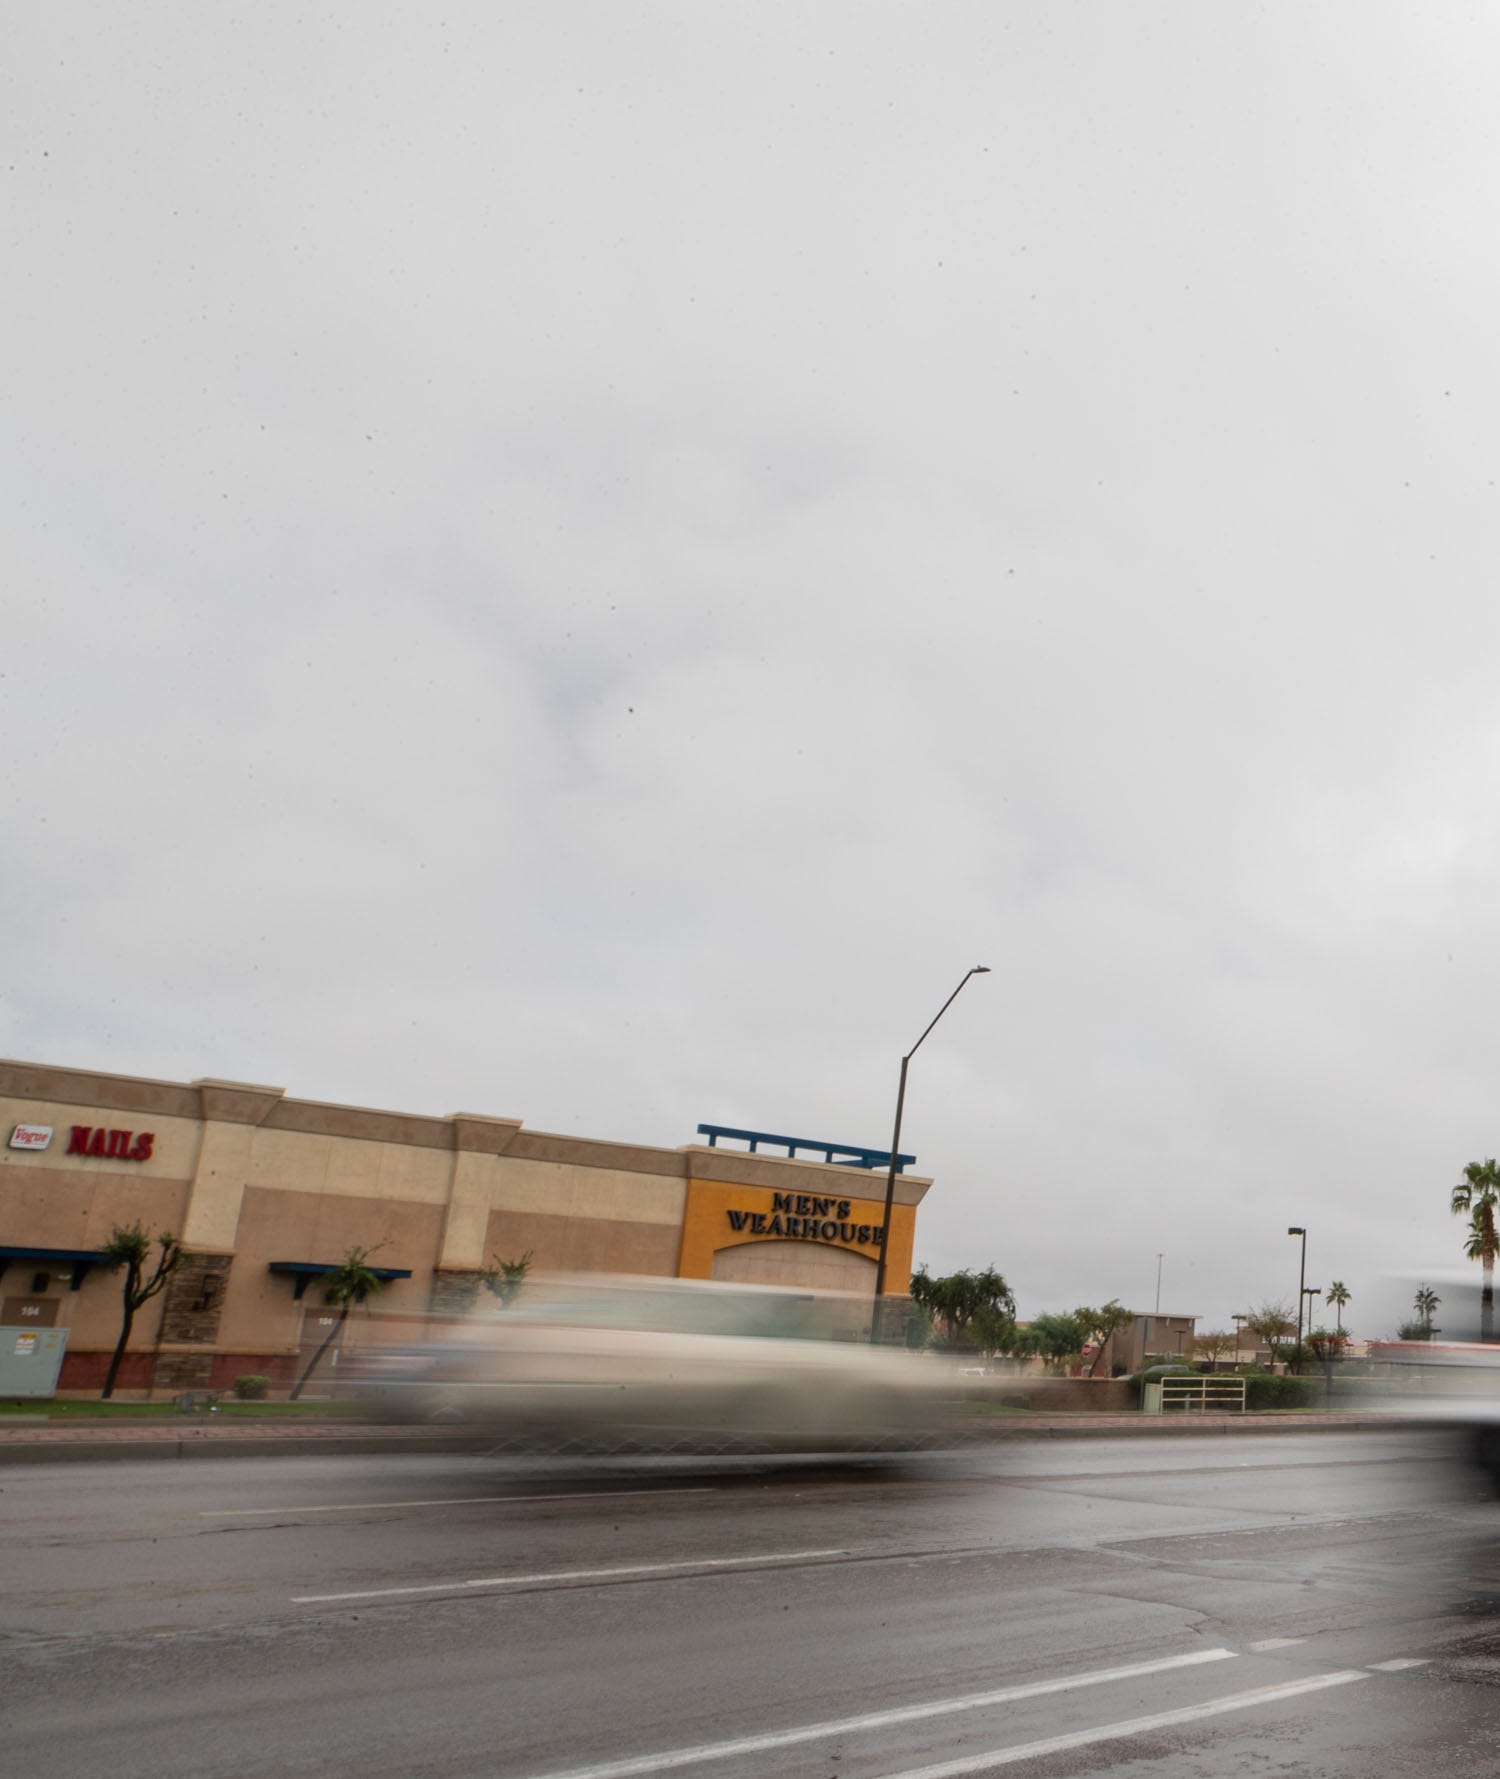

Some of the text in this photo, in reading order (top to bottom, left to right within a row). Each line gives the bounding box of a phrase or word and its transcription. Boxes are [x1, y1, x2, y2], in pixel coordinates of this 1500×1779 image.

[15, 1125, 155, 1161] Vogue NAILS
[771, 1192, 851, 1219] MEN'S
[727, 1210, 886, 1245] WEARHOUSE
